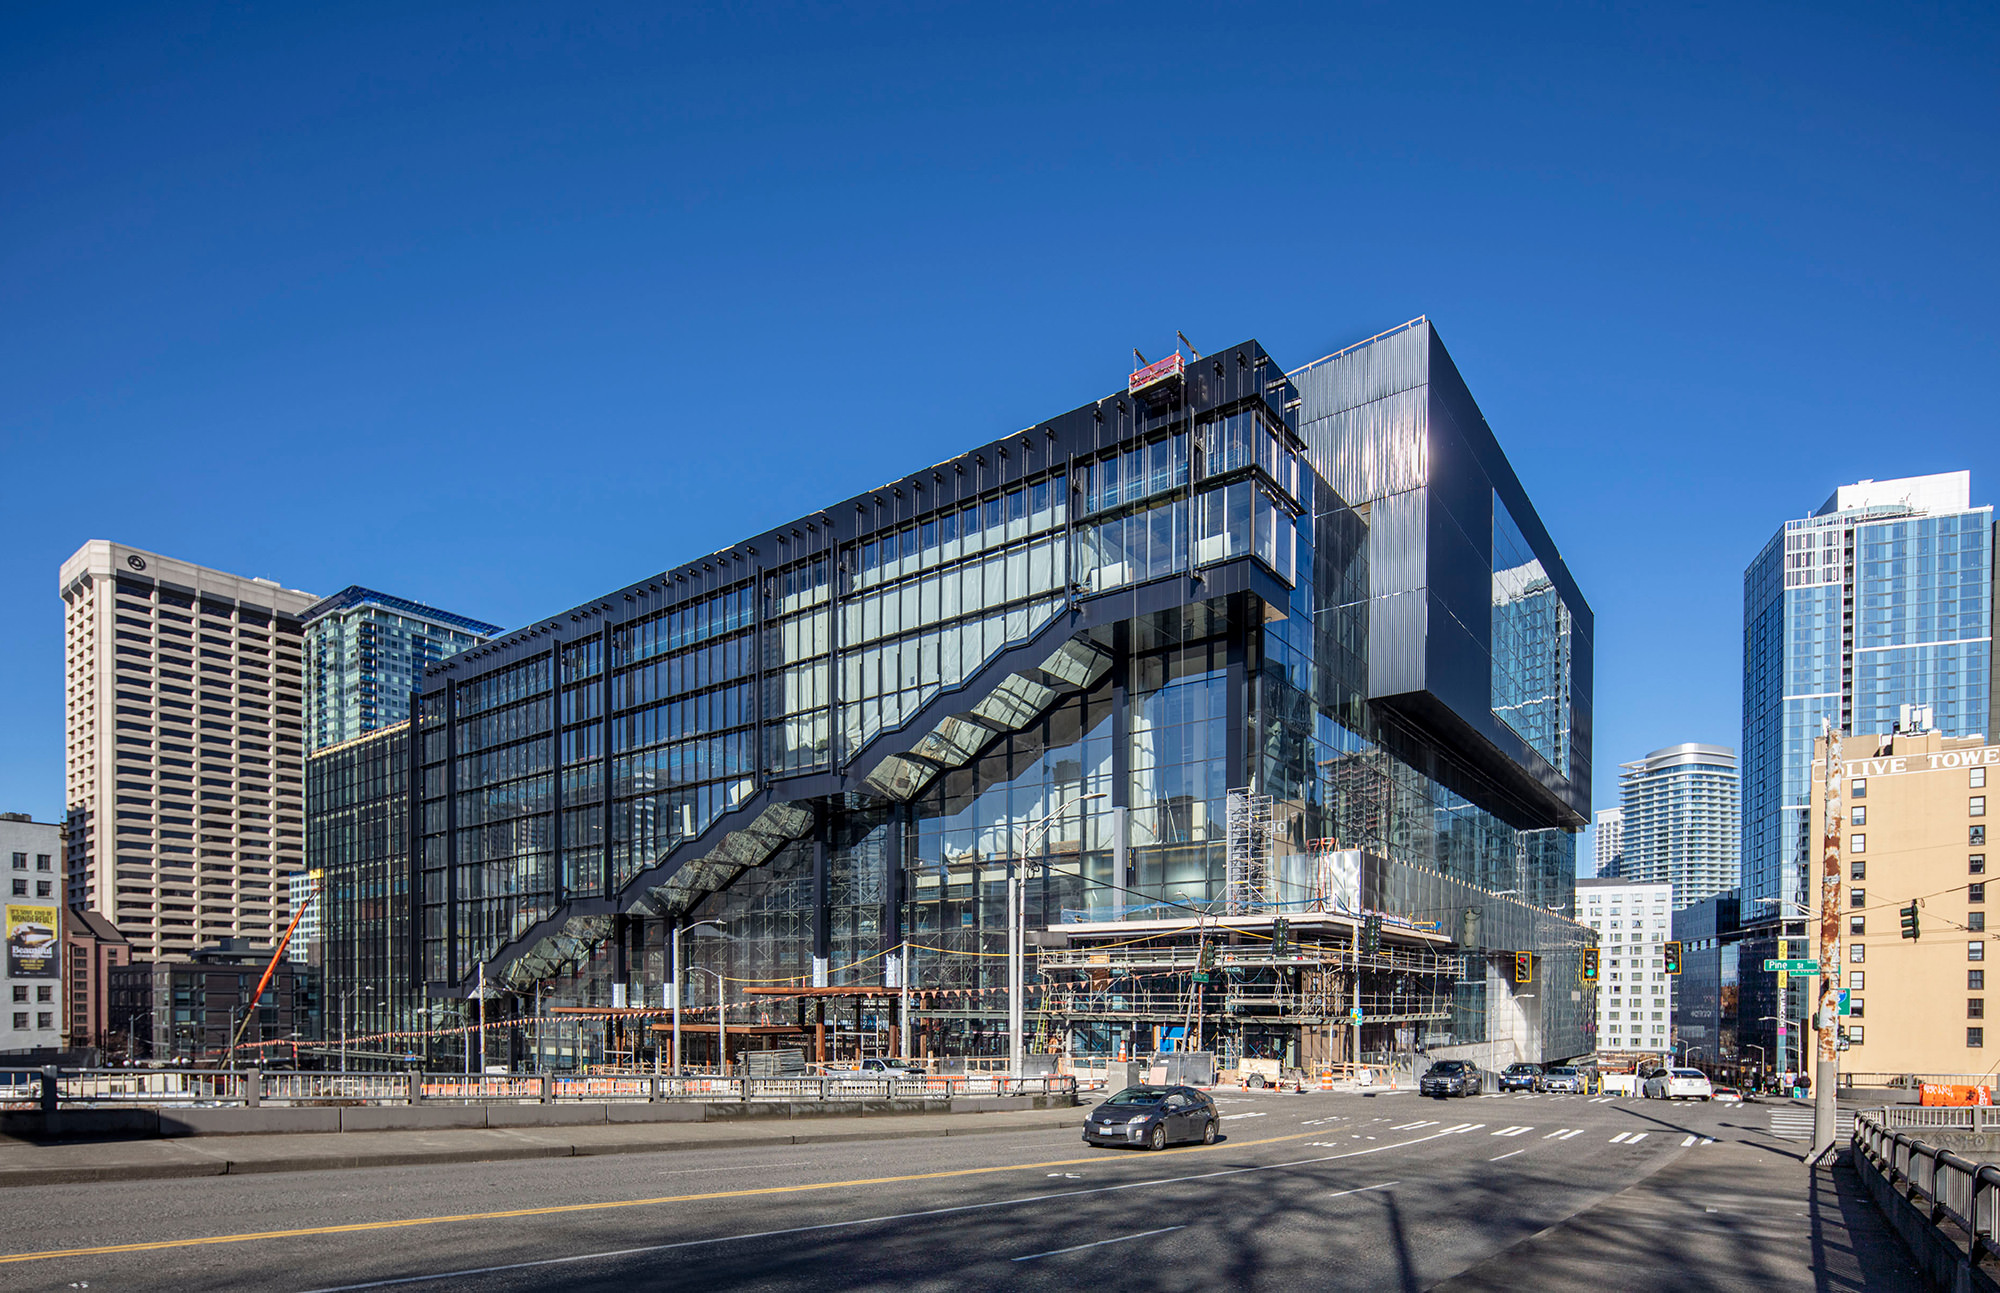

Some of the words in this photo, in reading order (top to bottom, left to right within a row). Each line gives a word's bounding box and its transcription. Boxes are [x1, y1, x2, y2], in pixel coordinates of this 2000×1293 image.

[1841, 758, 1907, 777] LIVE
[11, 915, 53, 924] WONDERFUL!
[1769, 961, 1788, 970] Pine
